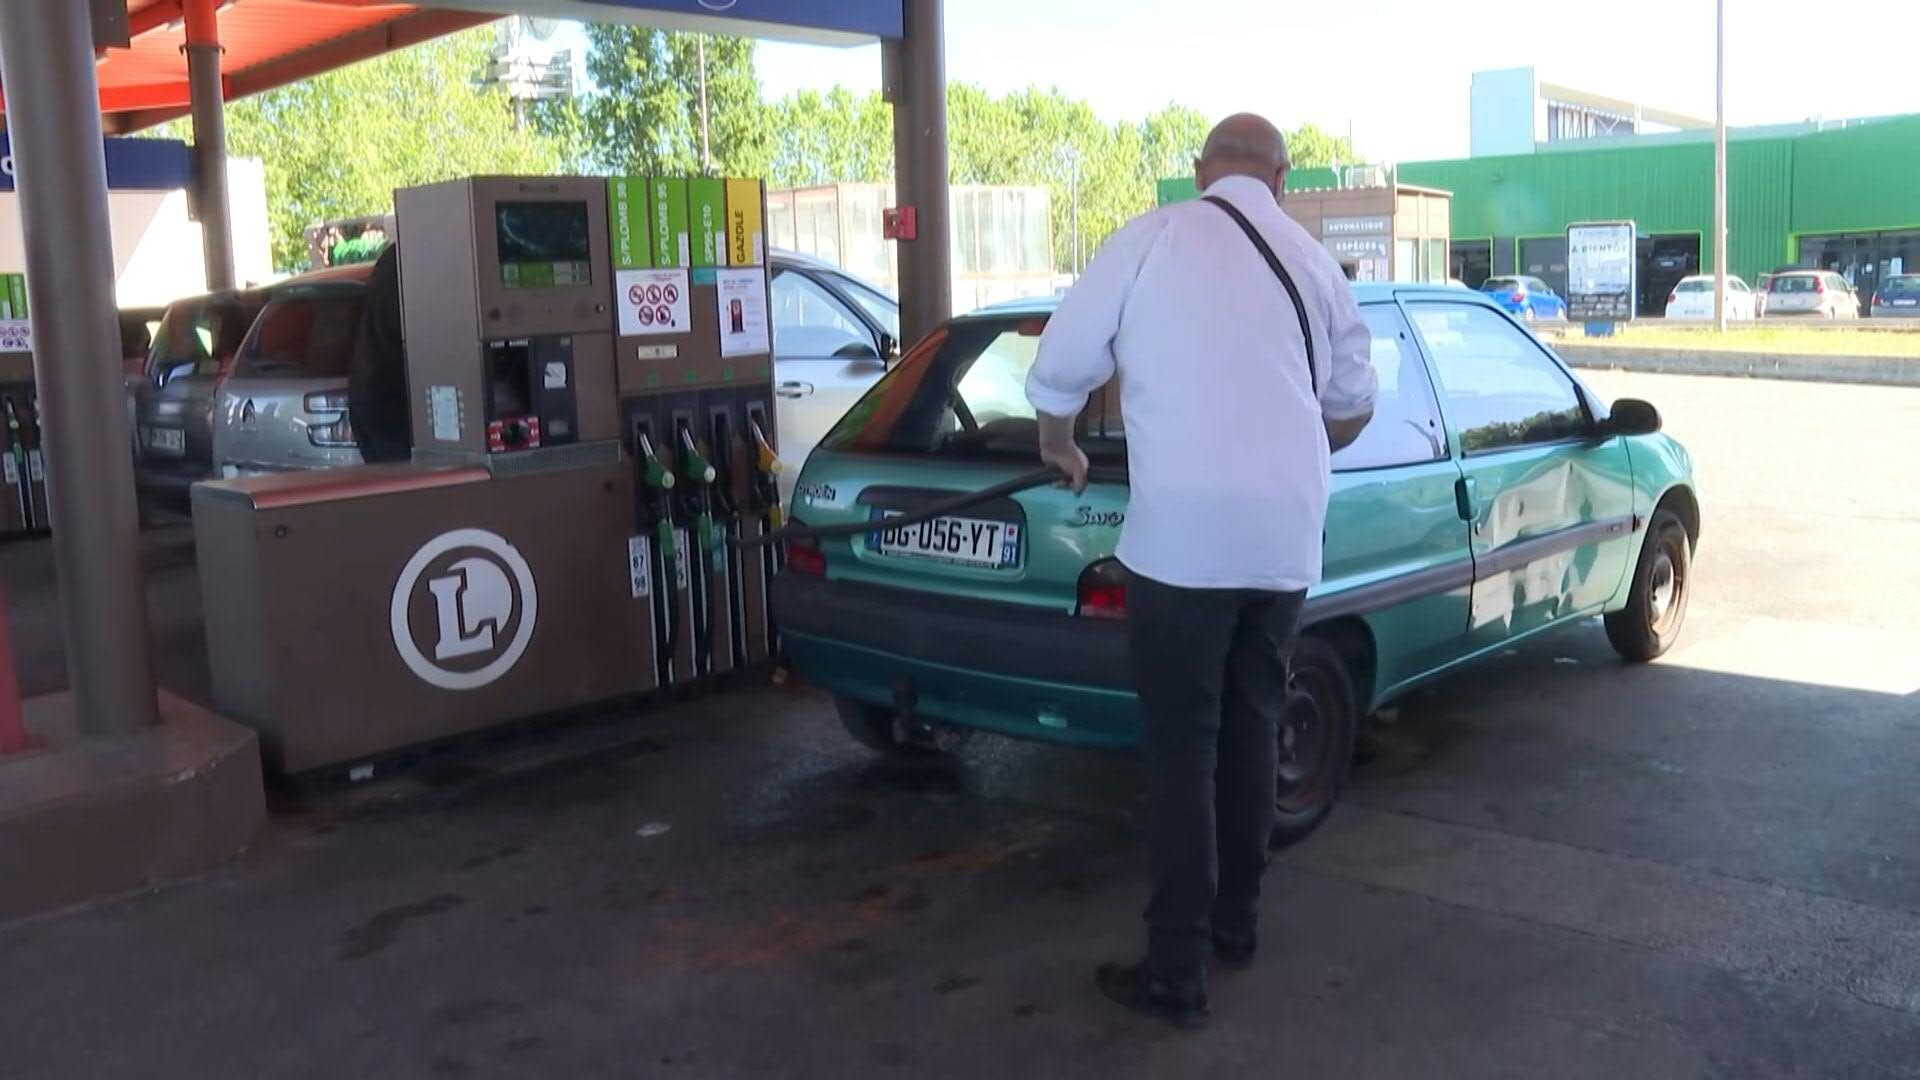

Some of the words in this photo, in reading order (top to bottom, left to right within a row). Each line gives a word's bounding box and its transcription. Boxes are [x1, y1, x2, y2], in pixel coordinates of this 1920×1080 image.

[657, 201, 671, 265] S/PLOMB
[734, 210, 745, 263] GAZOLE
[1003, 546, 1016, 561] 91
